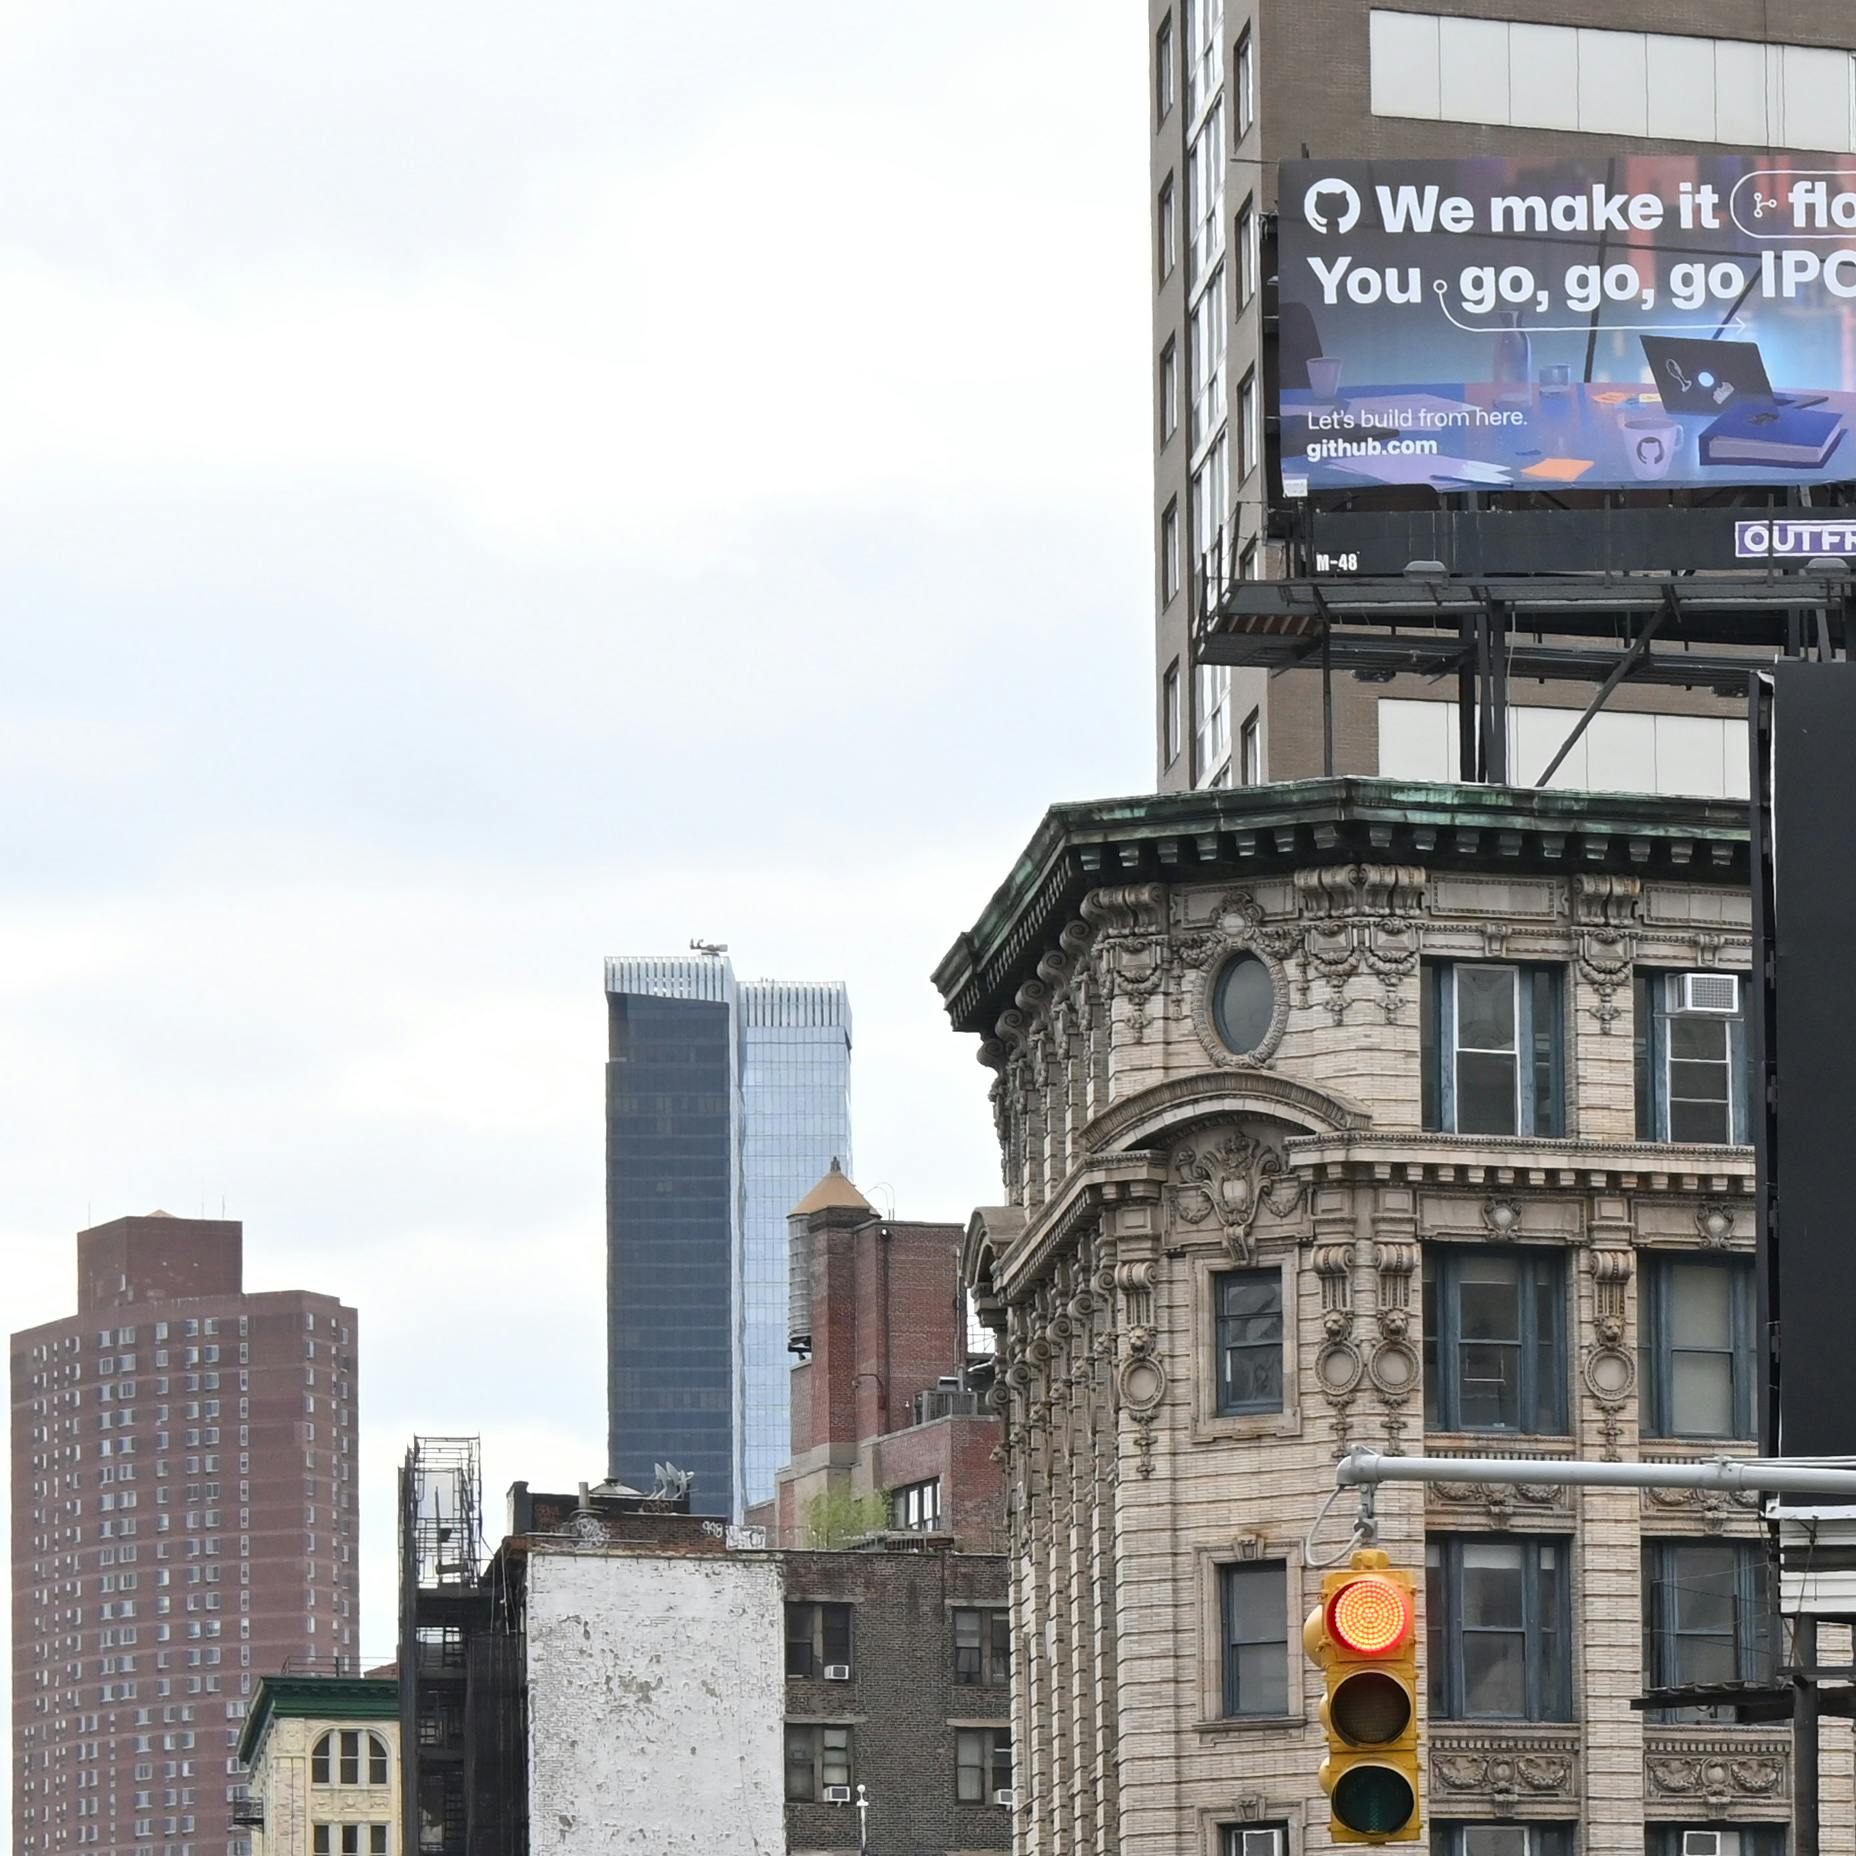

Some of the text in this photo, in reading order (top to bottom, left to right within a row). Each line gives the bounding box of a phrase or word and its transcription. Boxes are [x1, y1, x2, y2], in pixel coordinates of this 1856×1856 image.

[1376, 185, 1474, 233] We
[1490, 184, 1663, 232] make
[1679, 183, 1718, 229] it
[1307, 255, 1421, 304] You
[1459, 265, 1549, 313] go,
[1564, 264, 1655, 312] go,
[1670, 262, 1744, 310] go
[1308, 408, 1527, 430] Let's build from here.
[1307, 438, 1437, 462] github.com
[1316, 553, 1358, 571] M-48
